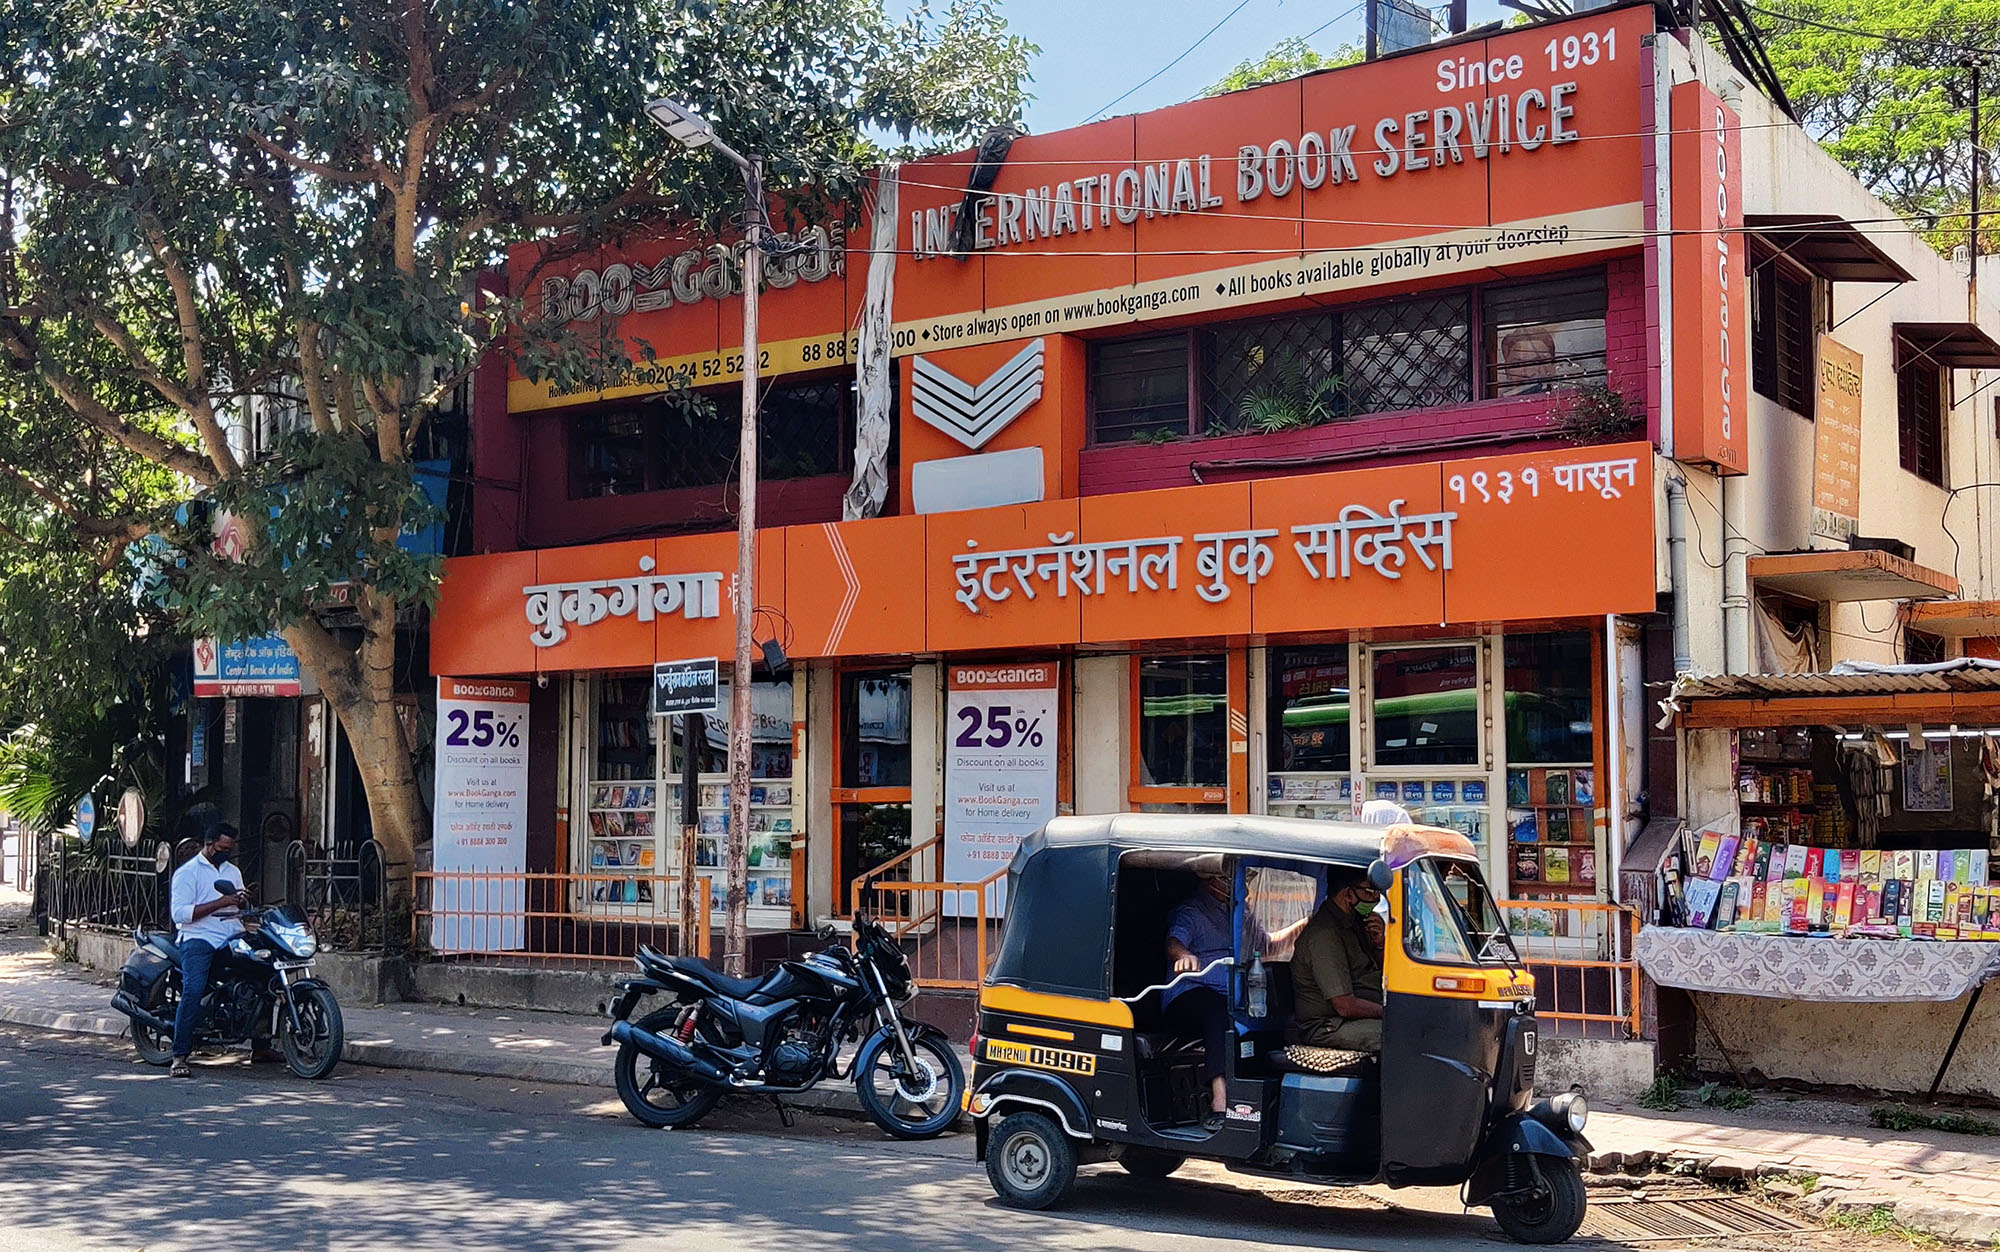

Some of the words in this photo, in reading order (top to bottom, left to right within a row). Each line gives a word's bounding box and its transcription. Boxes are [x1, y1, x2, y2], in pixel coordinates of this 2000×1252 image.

[1436, 54, 1523, 92] Since
[1544, 27, 1616, 72] 1931
[1237, 124, 1358, 201] BOOK
[1373, 81, 1578, 178] SERVICE
[932, 321, 963, 342] Store
[966, 316, 1008, 338] always
[1011, 312, 1041, 332] open
[1044, 309, 1060, 325] on
[1063, 284, 1200, 321] www.bookganga.com
[1228, 275, 1246, 297] All
[1251, 270, 1292, 293] books
[1297, 257, 1364, 285] available
[1370, 245, 1431, 277] globally
[1436, 243, 1453, 262] at
[1456, 237, 1492, 265] your
[1497, 225, 1570, 251] doorstep
[680, 361, 698, 380] 24
[703, 358, 720, 377] 52
[726, 354, 745, 374] 52
[757, 350, 770, 370] 2
[802, 344, 821, 362] 88
[826, 340, 845, 359] 88
[1449, 467, 1538, 504] १९३१
[1552, 458, 1638, 500] पासून
[1193, 528, 1278, 603] बुक
[522, 555, 723, 647] बुकगंगा
[225, 664, 248, 676] Central
[249, 664, 266, 675] Bank
[268, 663, 276, 675] of
[277, 663, 294, 675] India
[232, 685, 257, 696] HOURS
[259, 684, 275, 695] ATM
[446, 709, 520, 748] 25%
[956, 706, 1043, 748] 25%
[447, 755, 478, 764] Discount
[480, 757, 488, 765] on
[490, 756, 498, 764] all
[500, 755, 520, 764] books
[957, 758, 992, 767] Discount
[994, 759, 1005, 767] on
[1007, 758, 1016, 767] all
[1018, 758, 1044, 767] books
[466, 777, 480, 786] Visit
[491, 778, 497, 786] at
[979, 782, 995, 792] Visit
[997, 784, 1006, 792] us
[1007, 783, 1016, 792] at
[448, 789, 516, 799] www.BookGanga.com
[454, 800, 463, 808] for
[465, 801, 484, 809] Home
[485, 800, 510, 809] delivery
[957, 795, 1040, 807] www.BookGanga.com
[965, 807, 976, 816] for
[977, 808, 999, 817] Home
[1001, 807, 1031, 819] delivery
[967, 850, 981, 859] +91
[982, 850, 1000, 860] 8888
[1030, 1047, 1092, 1072] 0996
